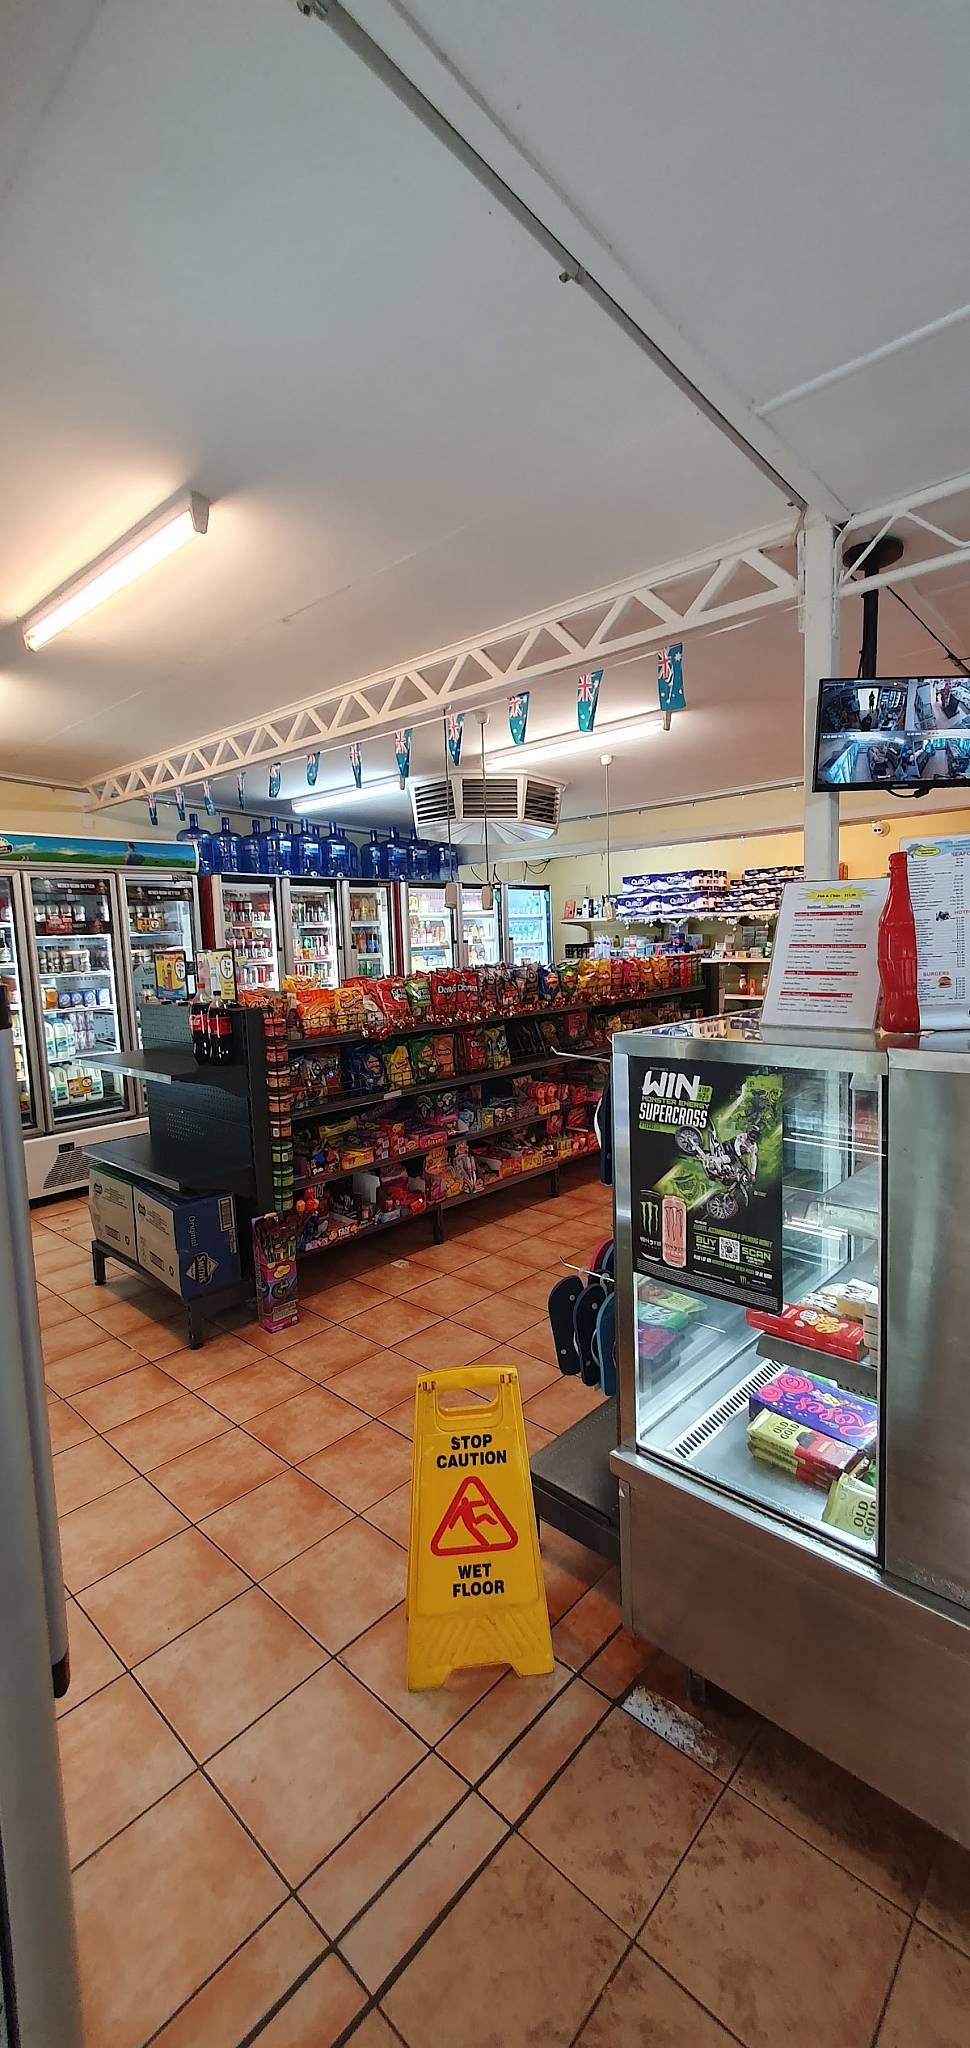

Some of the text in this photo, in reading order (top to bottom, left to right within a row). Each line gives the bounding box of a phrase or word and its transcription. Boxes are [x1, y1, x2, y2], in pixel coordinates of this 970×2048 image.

[670, 897, 690, 905] Quilton
[642, 1070, 701, 1101] WIN
[641, 1096, 710, 1110] MONSTER ENERGY
[639, 1102, 708, 1129] SUPERCROSS
[188, 1215, 199, 1247] Original
[695, 1235, 772, 1261] BUY SCAN
[773, 1421, 789, 1434] OLD
[780, 1423, 800, 1440] GOLD
[451, 1434, 493, 1451] STOP
[436, 1450, 507, 1469] CAUTION
[853, 1500, 869, 1528] OLD
[458, 1563, 492, 1579] WET
[452, 1580, 505, 1598] FLOOR
